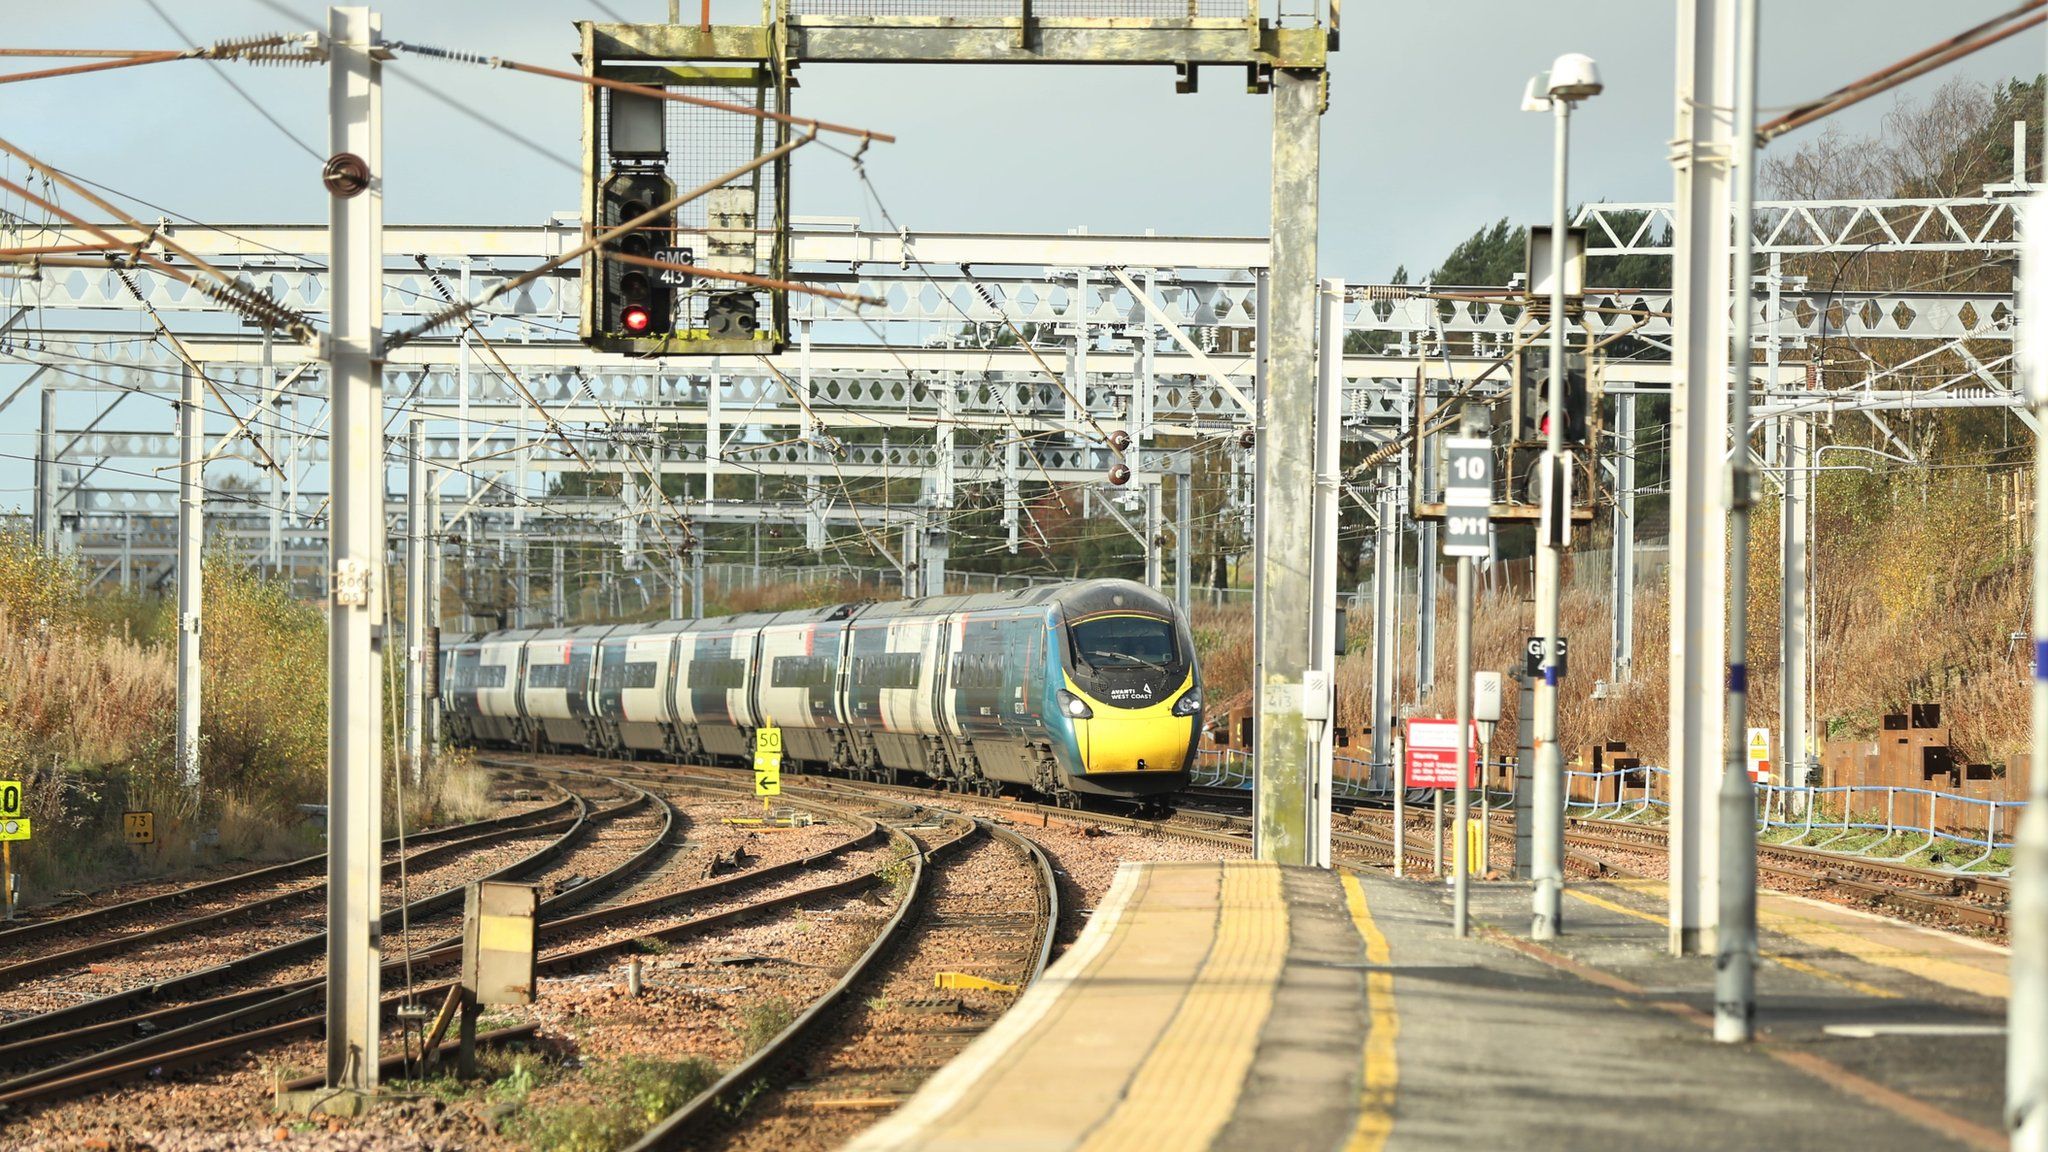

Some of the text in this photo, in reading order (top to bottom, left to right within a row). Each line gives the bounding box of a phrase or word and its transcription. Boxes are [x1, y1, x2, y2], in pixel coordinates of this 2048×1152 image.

[654, 251, 691, 265] GMC
[660, 269, 685, 284] 413
[1454, 456, 1485, 480] 10
[1448, 516, 1487, 536] 9/11
[760, 732, 779, 747] 50
[130, 815, 146, 827] 73
